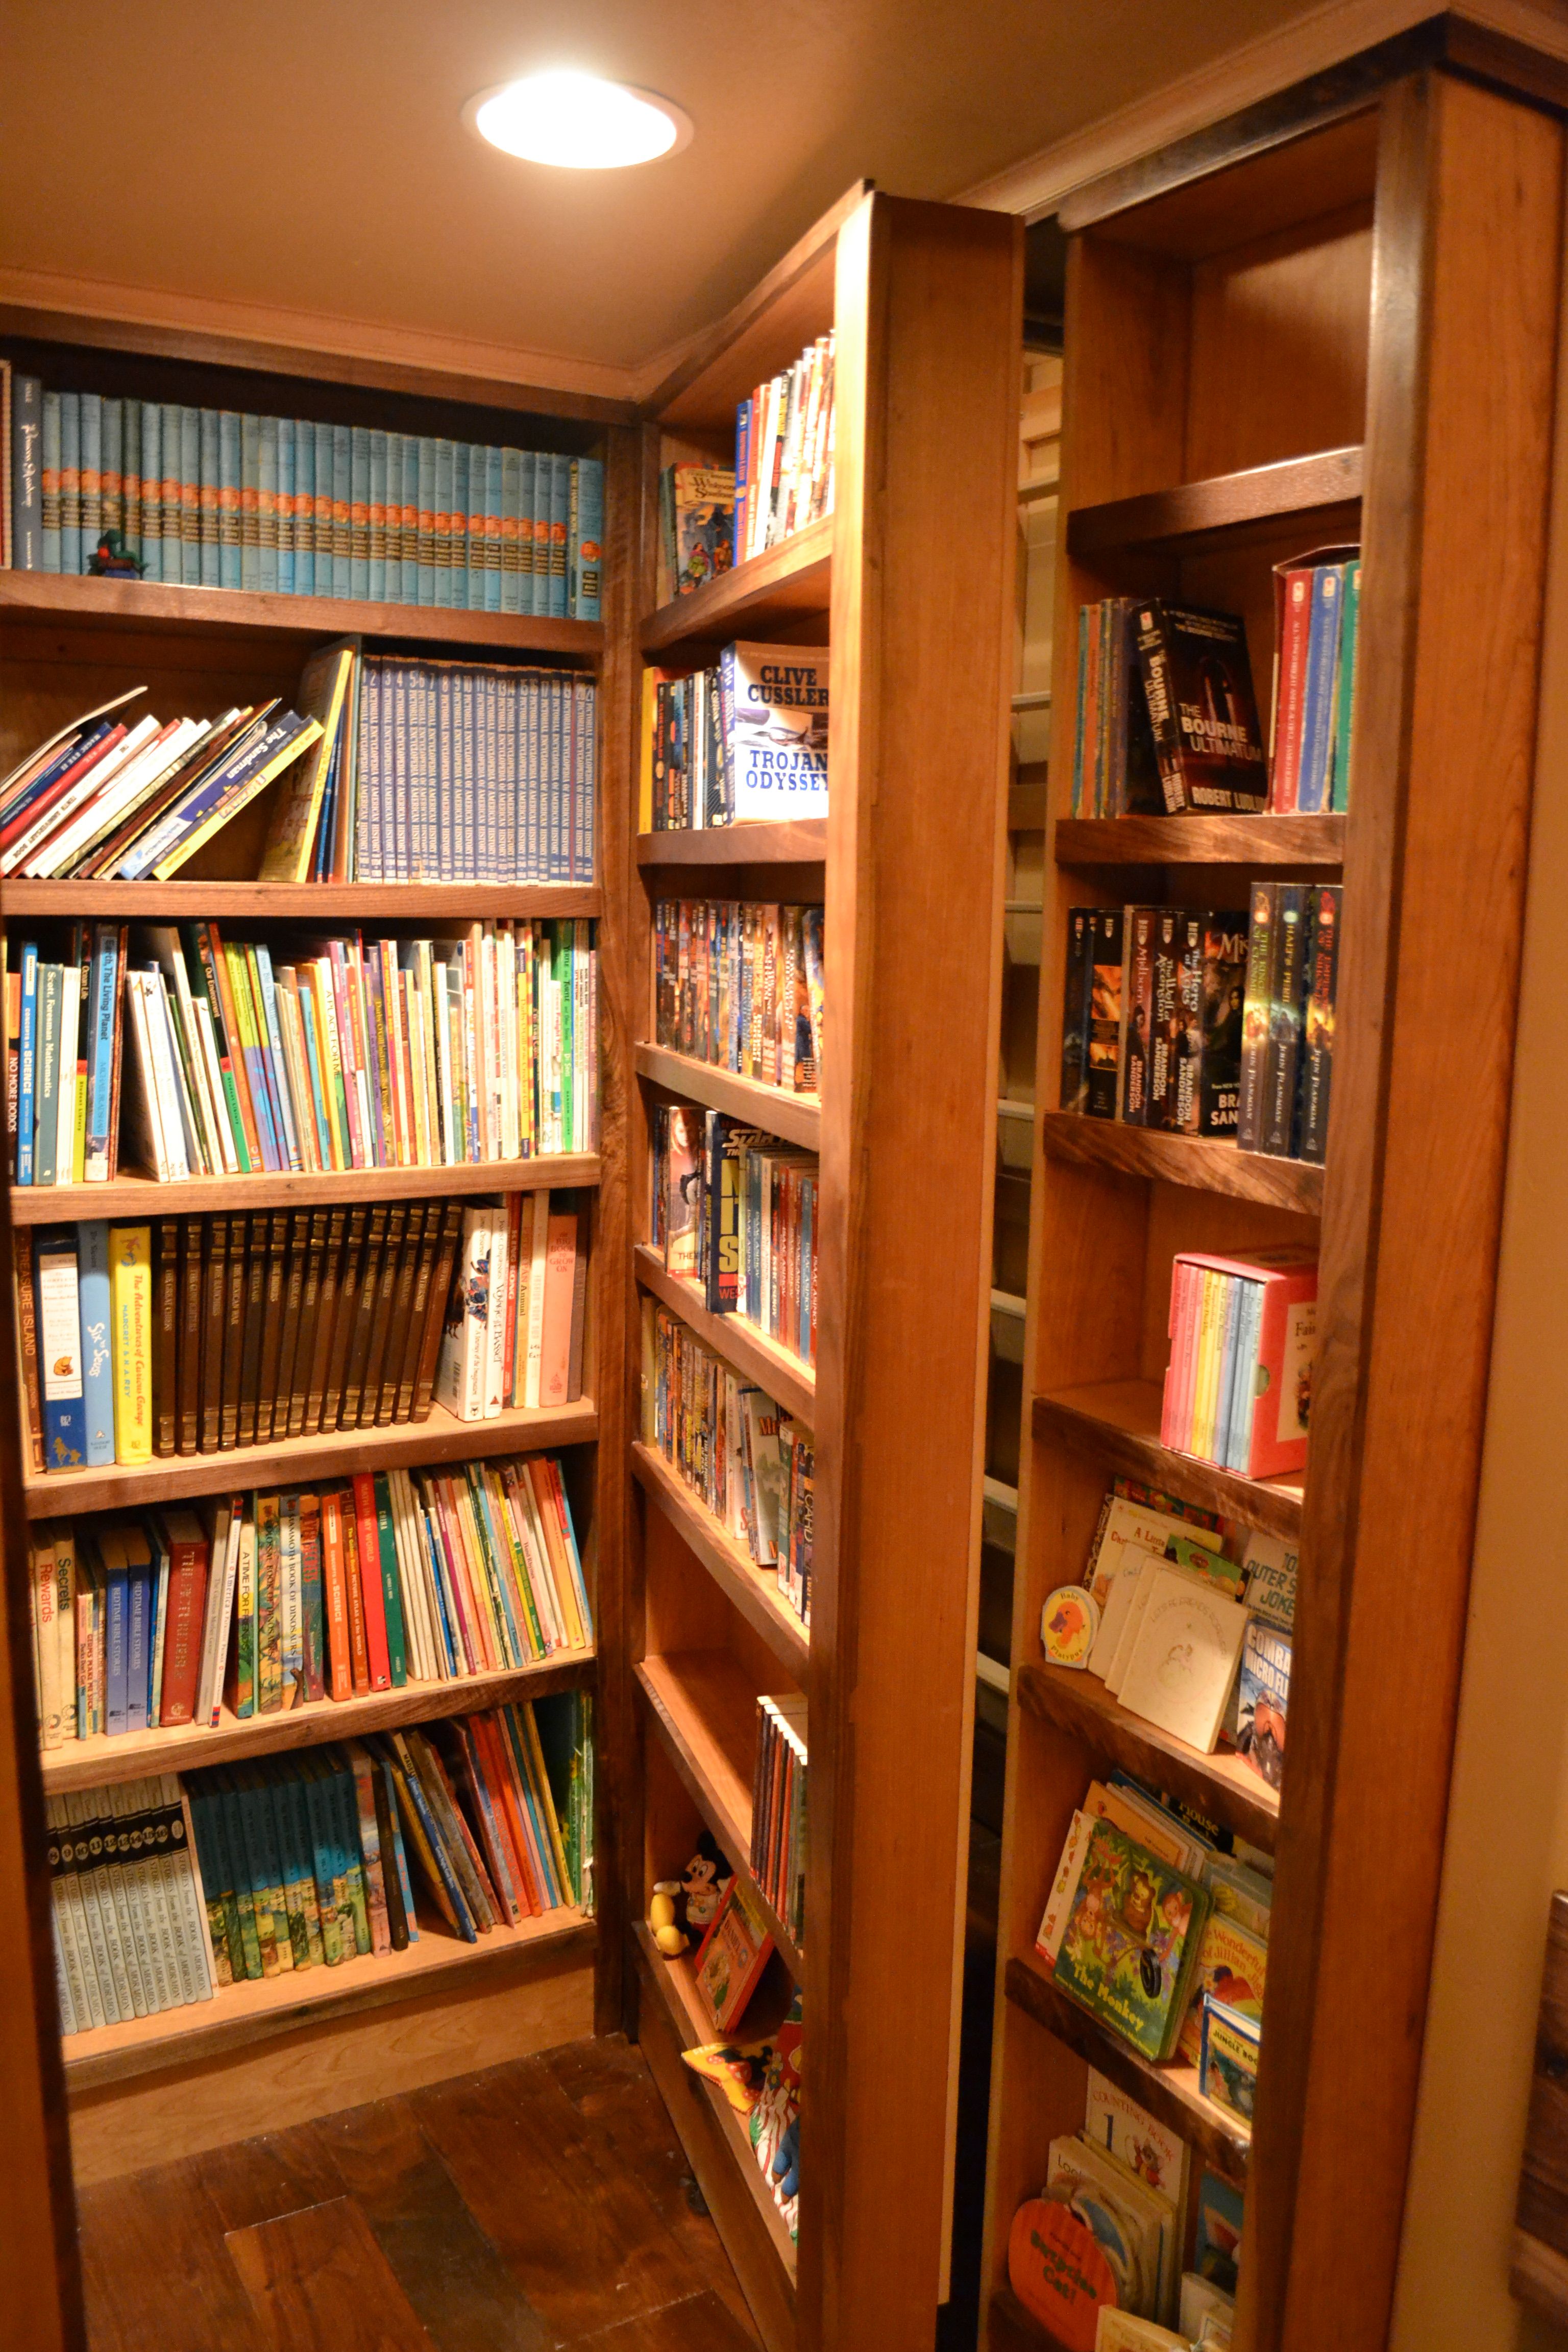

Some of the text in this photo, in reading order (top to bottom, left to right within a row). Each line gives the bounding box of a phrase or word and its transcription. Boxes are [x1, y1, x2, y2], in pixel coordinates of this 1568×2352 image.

[371, 669, 376, 685] 2
[385, 669, 391, 685] 3
[397, 670, 403, 687] 4
[761, 665, 817, 687] CLIVE
[1149, 655, 1170, 720] BOURNE
[370, 688, 378, 723] PICTORIAL
[397, 689, 405, 724] PICTORIAL
[748, 684, 828, 707] CUSSLER
[1144, 680, 1163, 742] ULTIMATUM
[1179, 703, 1201, 718] THE
[1180, 716, 1248, 743] BOURNE
[226, 727, 287, 779] The Sandman
[371, 725, 379, 775] ENCYCLOPEDIA
[397, 726, 405, 776] ENCYCLOPEDIA
[750, 749, 828, 772] TROJAN
[1190, 735, 1263, 762] ULTIMATUM
[371, 786, 380, 822] AMERICAN
[397, 786, 406, 822] AMERICAN
[1191, 786, 1232, 807] ROBERT
[28, 810, 61, 844] ANNIVERSARY
[371, 824, 380, 853] HISTORY
[397, 824, 406, 852] HISTORY
[12, 842, 29, 860] BOOK
[81, 965, 90, 1000] Ocean Life
[100, 939, 114, 1041] Earth, The Living Planet
[563, 981, 571, 1002] TURTLE
[1136, 946, 1149, 1004] Mistborn
[1155, 952, 1167, 1022] Ascension
[1181, 965, 1193, 1006] Ages
[1190, 970, 1202, 1012] Hero
[1282, 971, 1292, 1003] PERIL
[207, 979, 220, 1018] Environment
[1165, 976, 1177, 1010] Well
[327, 1000, 337, 1034] PLACE
[44, 971, 56, 1098] Scott, Foresman Mathematics
[330, 1036, 340, 1062] FOR
[374, 999, 382, 1021] Darby
[380, 1068, 389, 1087] Good
[23, 1050, 33, 1094] SCIENCE
[333, 1065, 340, 1077] ME
[1153, 1037, 1163, 1101] SANDERSON
[1159, 1043, 1168, 1096] BRANDON
[1275, 1043, 1287, 1123] JOHN FLANAGAN
[8, 1057, 18, 1133] NO MORE DODOS
[1176, 1057, 1187, 1126] SANDERSON
[1183, 1064, 1194, 1121] BRANDON
[1310, 1048, 1321, 1130] JOHN FLANAGAN
[549, 1257, 575, 1265] GROW
[556, 1265, 568, 1273] ON
[508, 1265, 517, 1300] KONG
[19, 1245, 36, 1356] TREASURE ISLAND
[520, 1285, 528, 1316] Annual
[87, 1322, 105, 1343] Six
[493, 1329, 503, 1363] BASSET
[89, 1349, 109, 1377] Seuss
[134, 1275, 145, 1426] The Adventures of Curious George
[361, 1483, 370, 1506] MATH
[364, 1518, 372, 1531] MY
[379, 1510, 388, 1531] CHINA
[365, 1533, 375, 1562] WORLD
[57, 1557, 71, 1611] Secrets
[287, 1513, 298, 1656] MAMMOTH BOOK OF DINOSAURS
[527, 1556, 535, 1580] Rhymes
[1246, 1559, 1288, 1591] OUTER
[40, 1563, 55, 1624] Rewards
[224, 1573, 235, 1609] America
[332, 1585, 342, 1623] SCIENCE
[1060, 1591, 1080, 1602] Baby
[112, 1587, 121, 1677] BEDTIME BIBLE STORIES
[1050, 1644, 1084, 1661] Platypus
[1245, 1647, 1275, 1689] MICRO
[77, 1846, 87, 1857] 10
[90, 1840, 101, 1852] 11
[105, 1839, 116, 1850] 12
[131, 1834, 142, 1845] 14
[179, 1854, 191, 1892] STORIES
[188, 1921, 197, 1942] BOOK
[193, 1954, 207, 1991] MORMON
[1074, 1963, 1094, 1990] The
[1097, 1982, 1144, 2032] Monkey
[1213, 2028, 1242, 2055] JUNGLE
